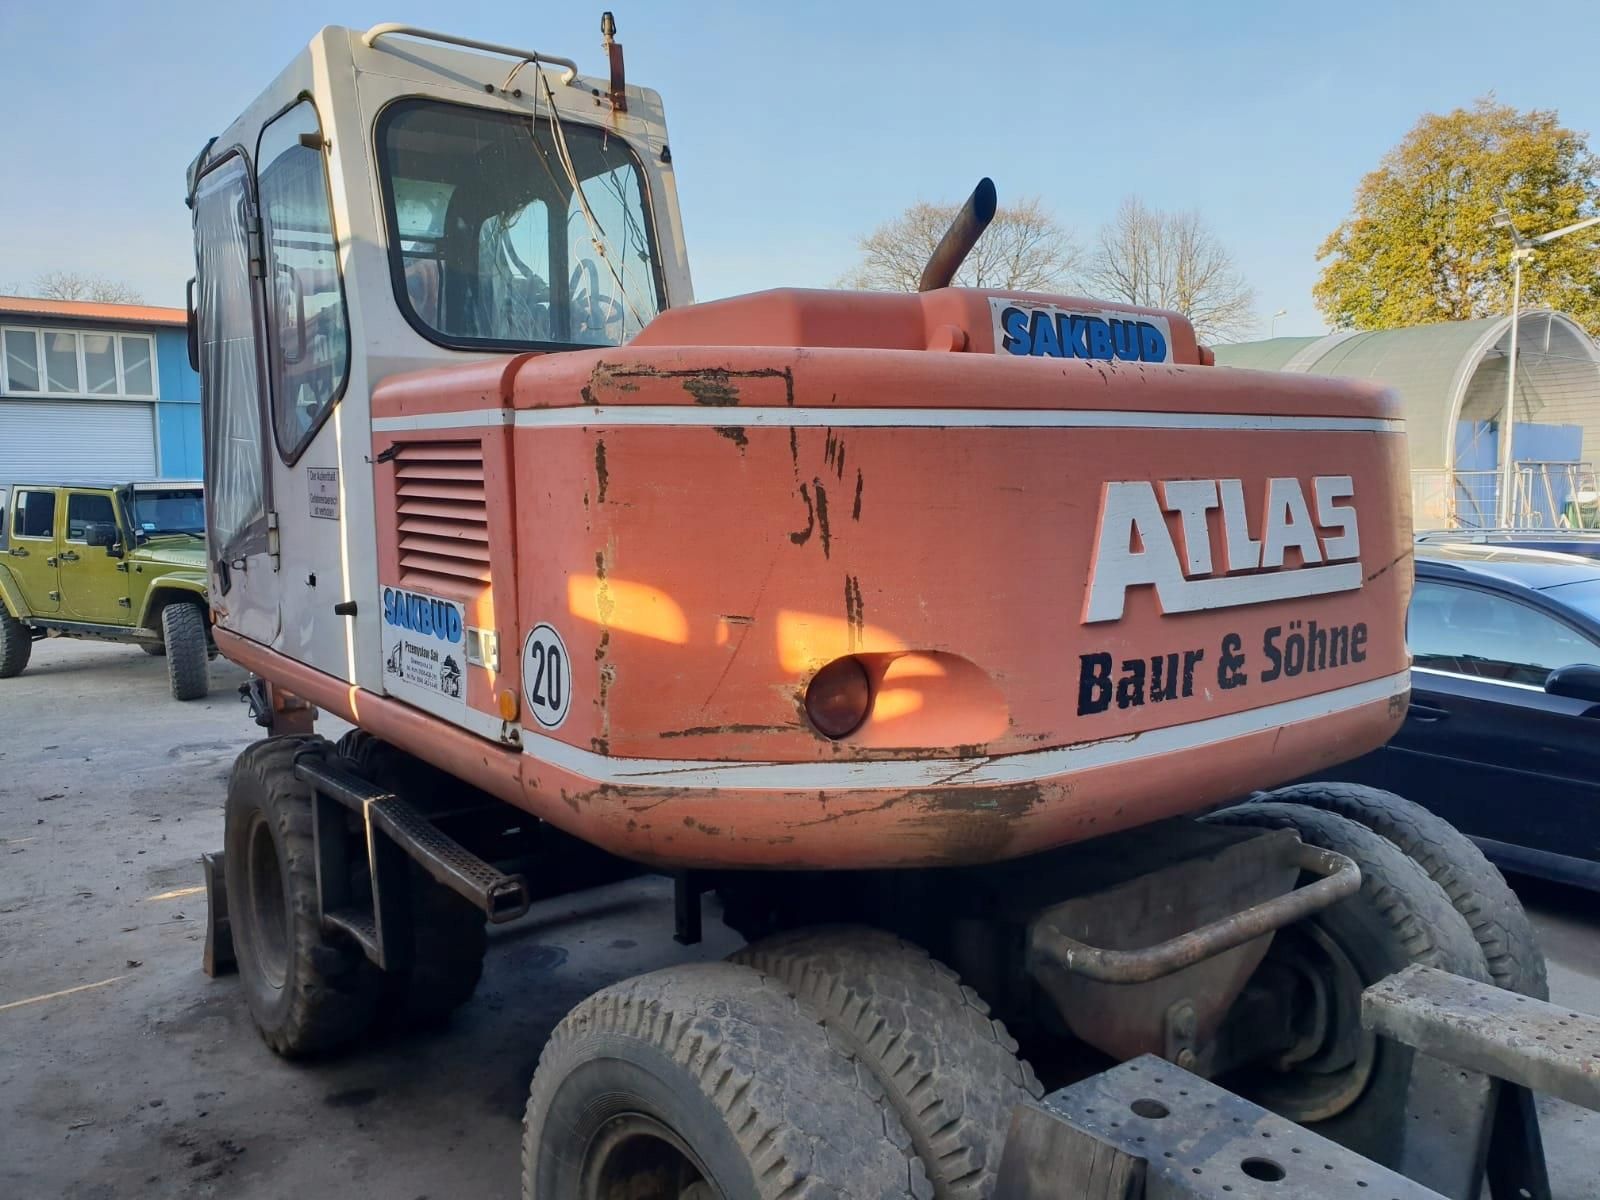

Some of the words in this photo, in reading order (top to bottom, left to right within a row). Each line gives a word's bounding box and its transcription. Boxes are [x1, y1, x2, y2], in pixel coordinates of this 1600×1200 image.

[1001, 306, 1167, 363] SAKBUD
[1081, 475, 1363, 624] ATLAS
[384, 588, 462, 643] SAKBUD
[532, 640, 561, 711] 20
[1077, 648, 1204, 716] Baur
[1217, 633, 1248, 689] &
[1261, 619, 1368, 682] Söhne
